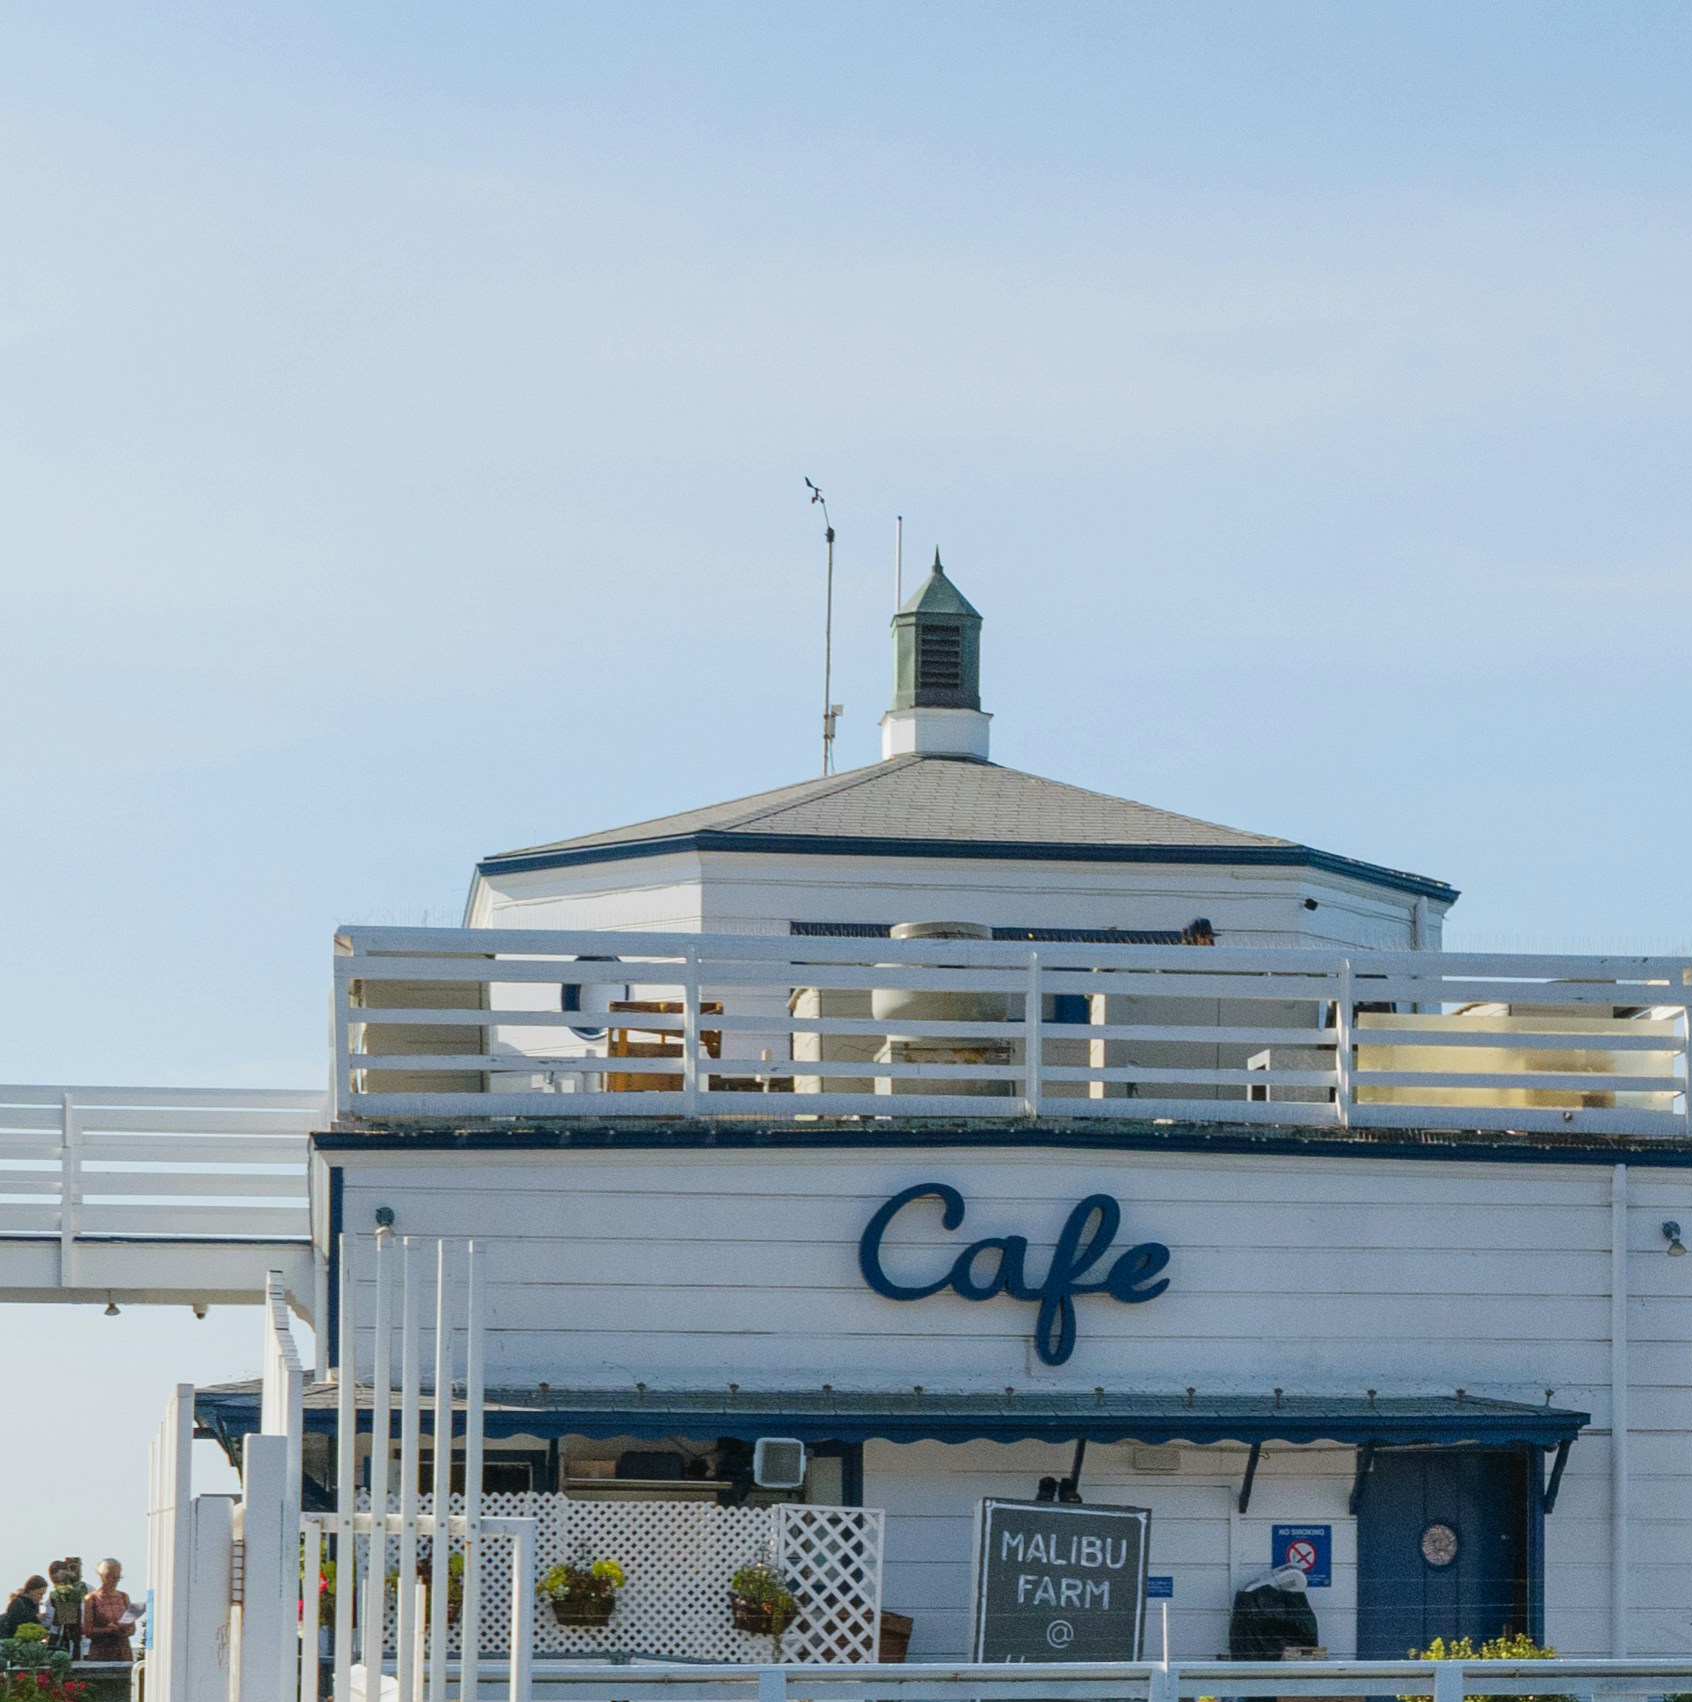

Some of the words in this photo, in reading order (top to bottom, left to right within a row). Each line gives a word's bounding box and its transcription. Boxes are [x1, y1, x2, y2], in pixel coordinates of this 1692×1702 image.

[859, 1182, 1171, 1366] Cafe
[1001, 1530, 1128, 1569] MALIBU
[1279, 1528, 1290, 1536] NO
[1017, 1573, 1110, 1611] FARM
[1046, 1619, 1074, 1649] @
